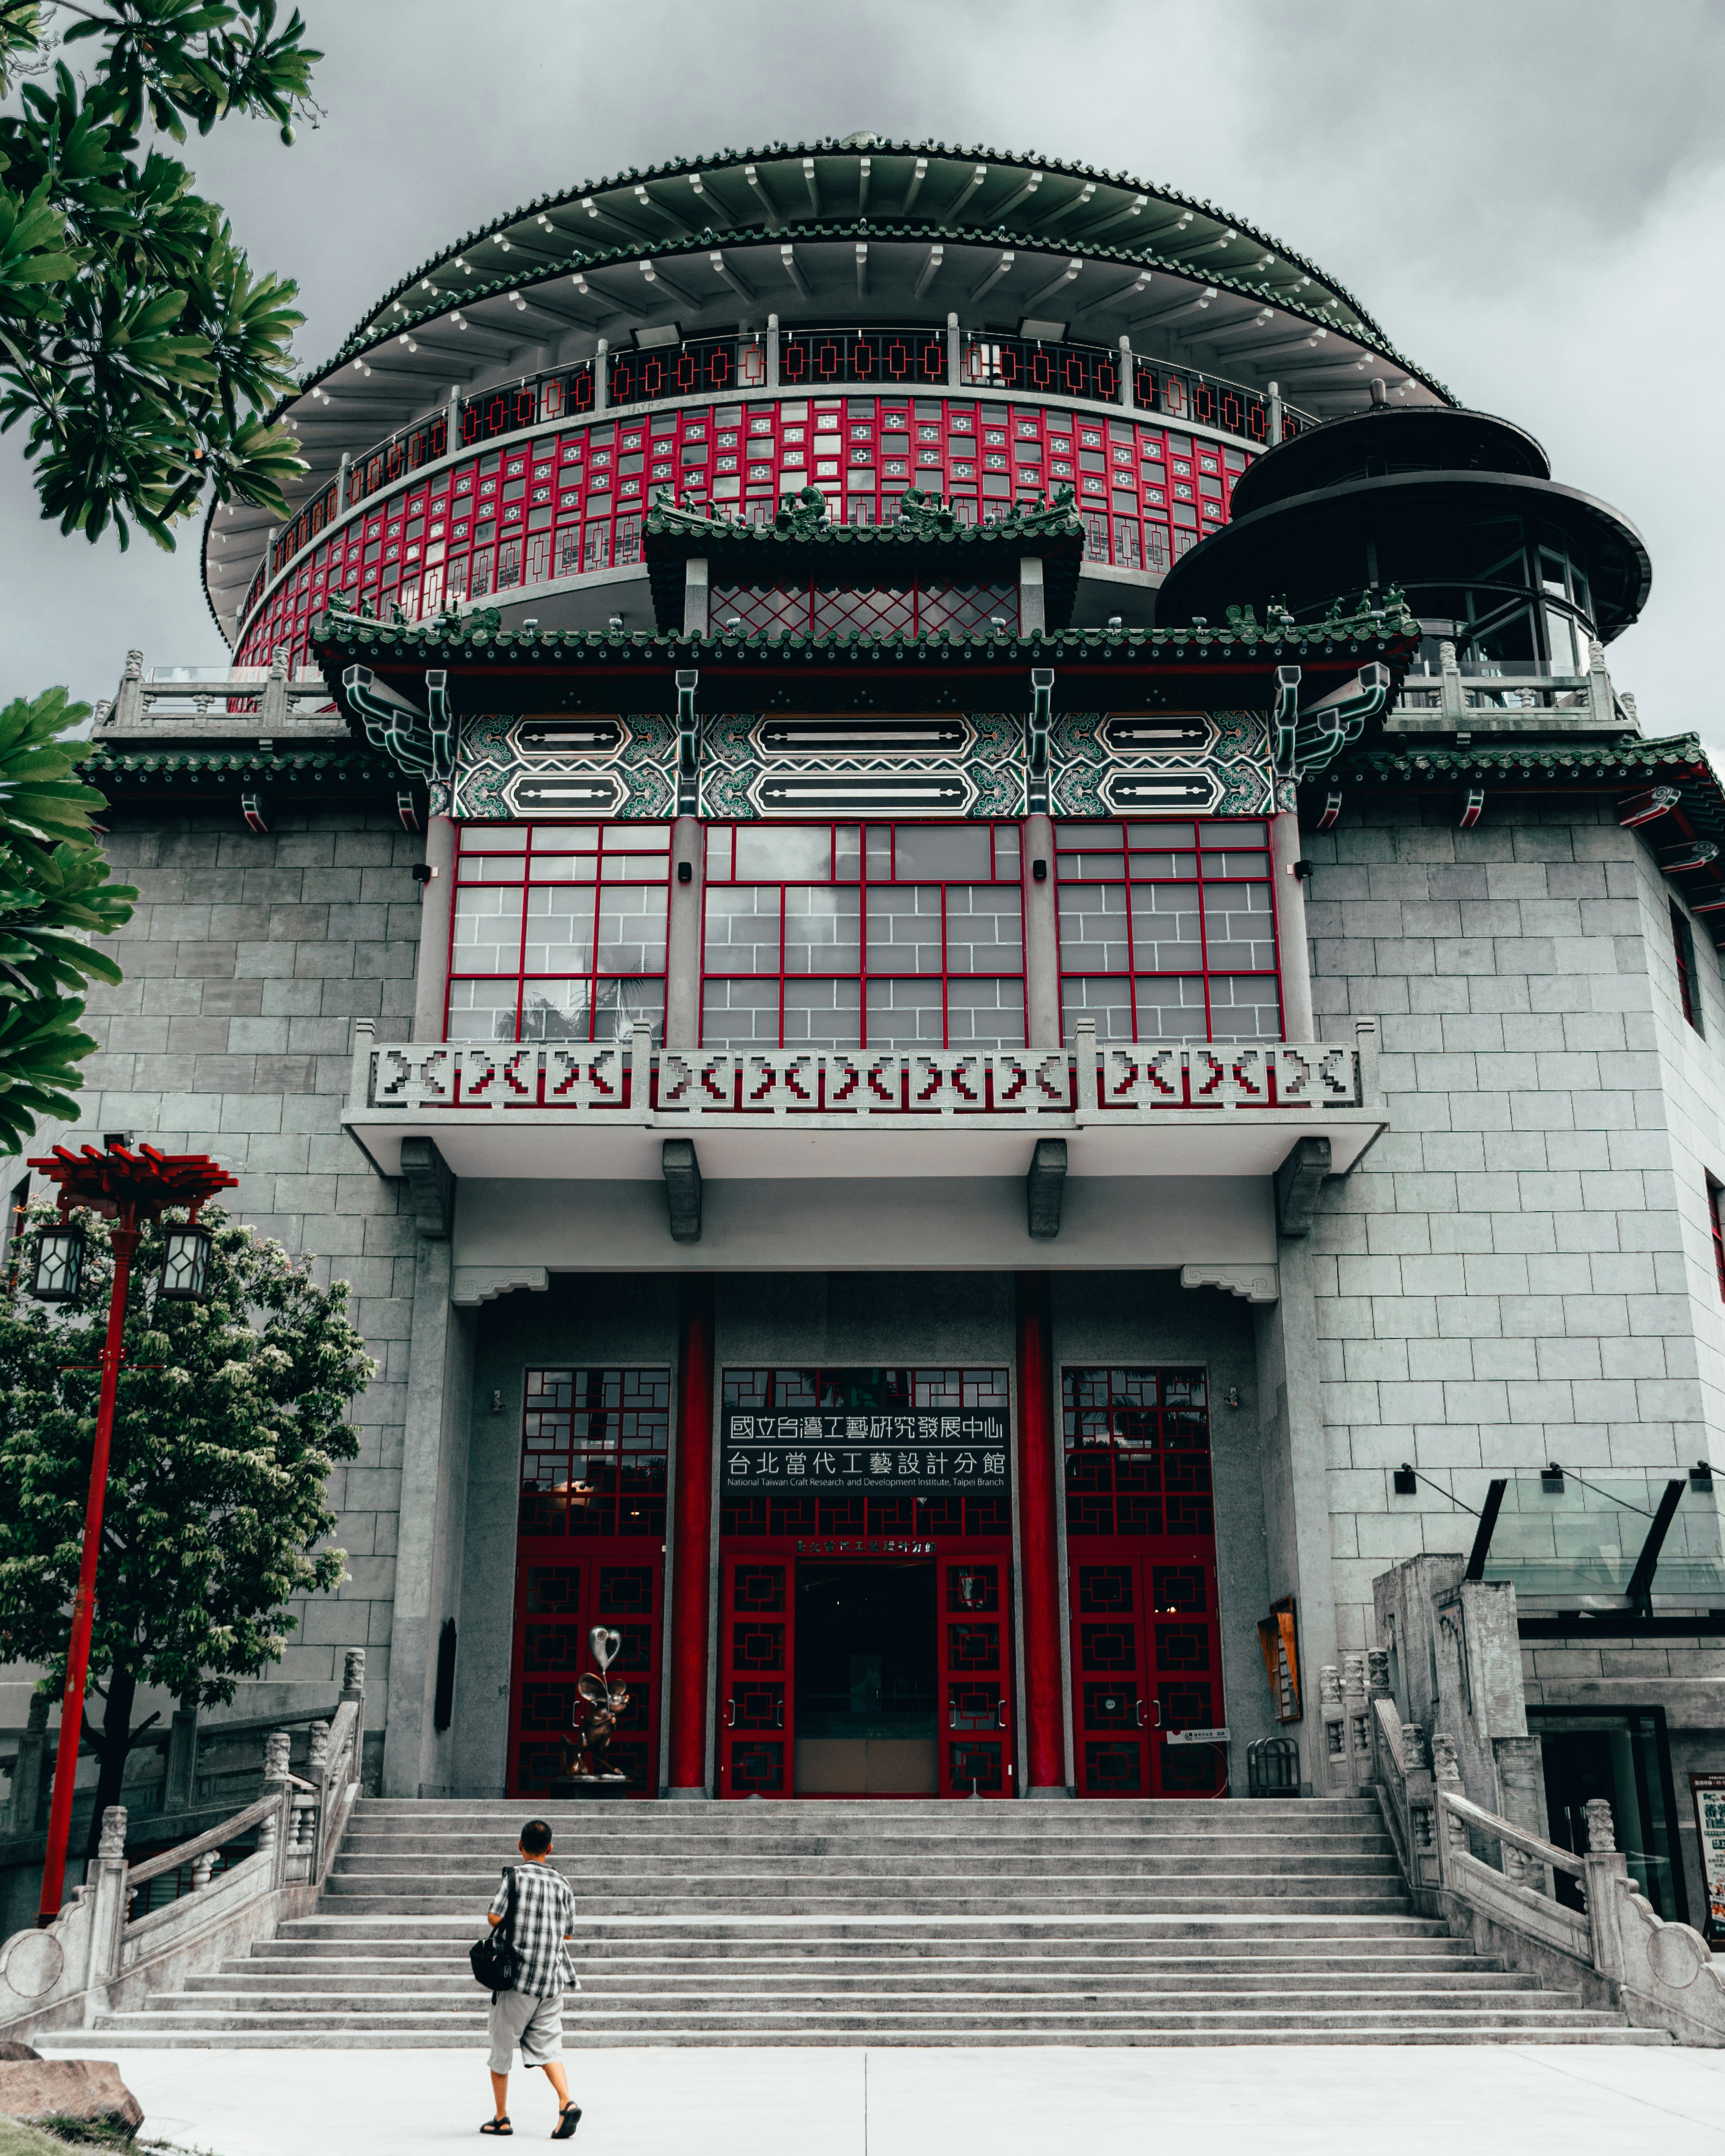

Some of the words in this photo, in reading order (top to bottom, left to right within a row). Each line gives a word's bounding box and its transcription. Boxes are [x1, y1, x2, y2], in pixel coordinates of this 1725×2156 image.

[731, 1416, 1002, 1439] 國立台灣工藝研究發展中心
[728, 1451, 1005, 1474] 台北當代工藝設計分館
[790, 1478, 808, 1486] Craft
[864, 1478, 916, 1487] Development
[918, 1478, 951, 1486] Institute,
[953, 1478, 975, 1487] Taipei
